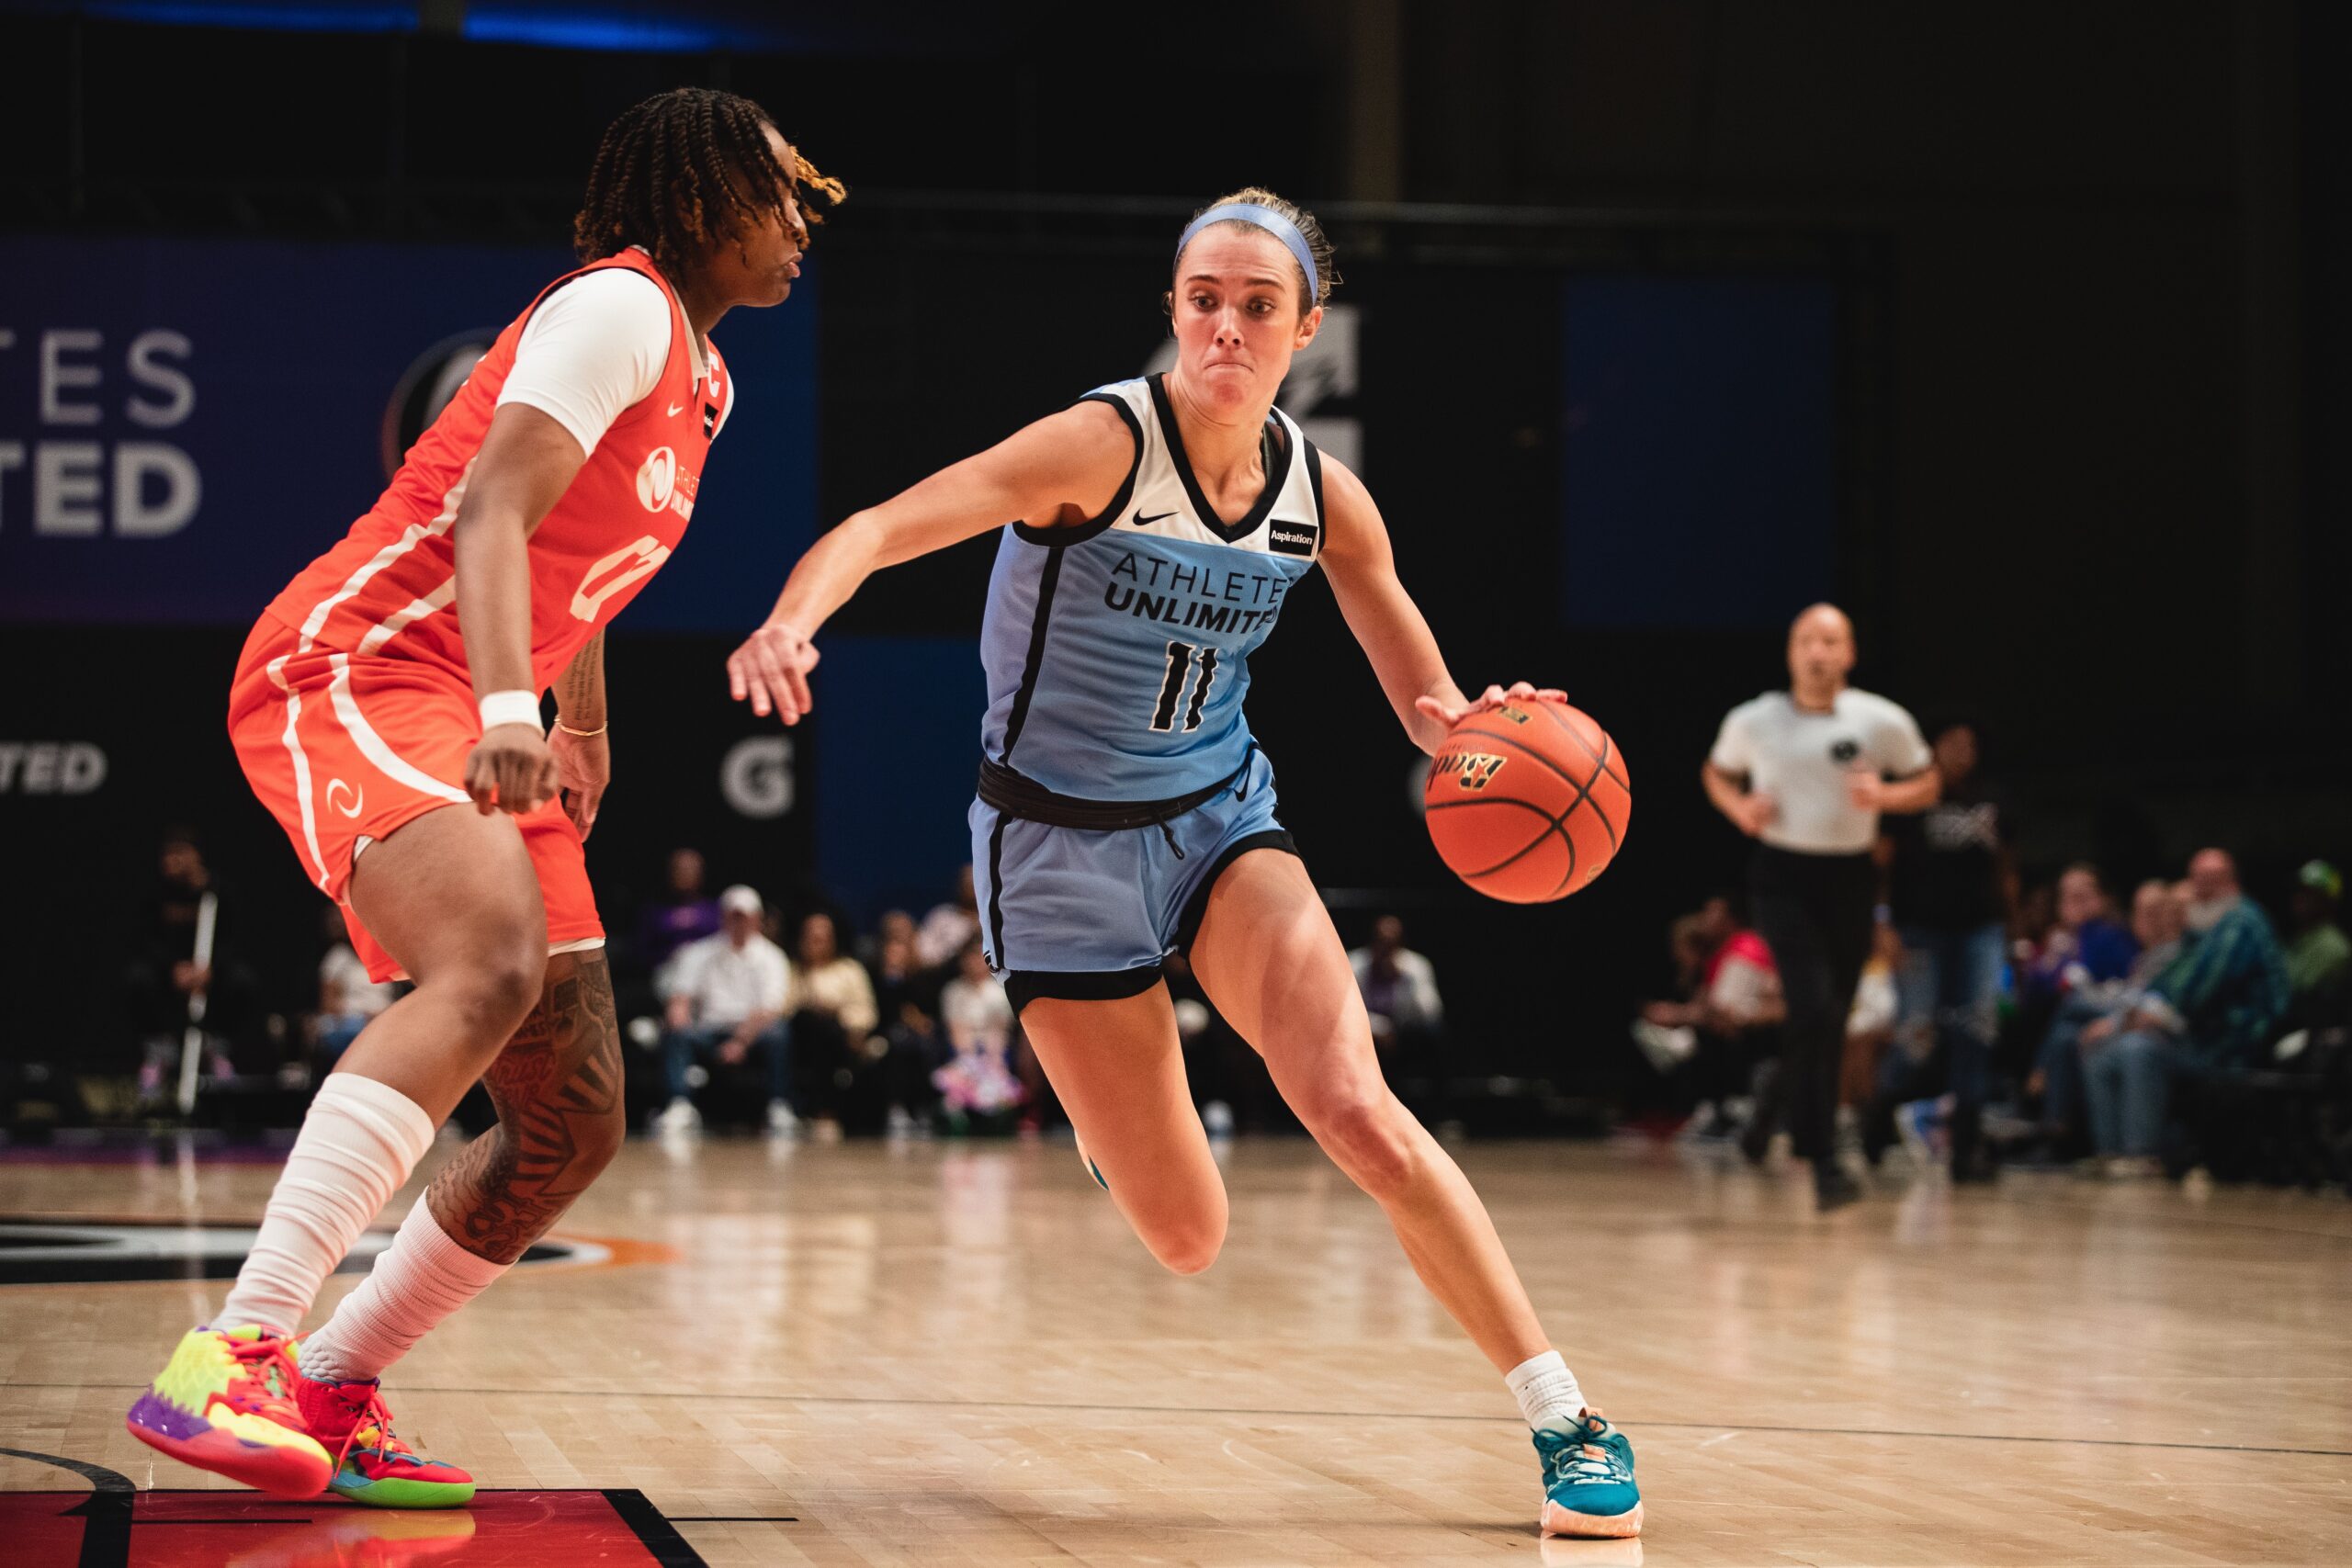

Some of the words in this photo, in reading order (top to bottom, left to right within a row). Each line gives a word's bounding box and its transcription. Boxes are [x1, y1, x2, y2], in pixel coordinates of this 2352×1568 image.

[0, 329, 197, 428] ES
[1111, 552, 1291, 604] ATHLETE
[1271, 529, 1314, 546] Aspiration
[1148, 640, 1219, 733] 11
[720, 736, 794, 818] G
